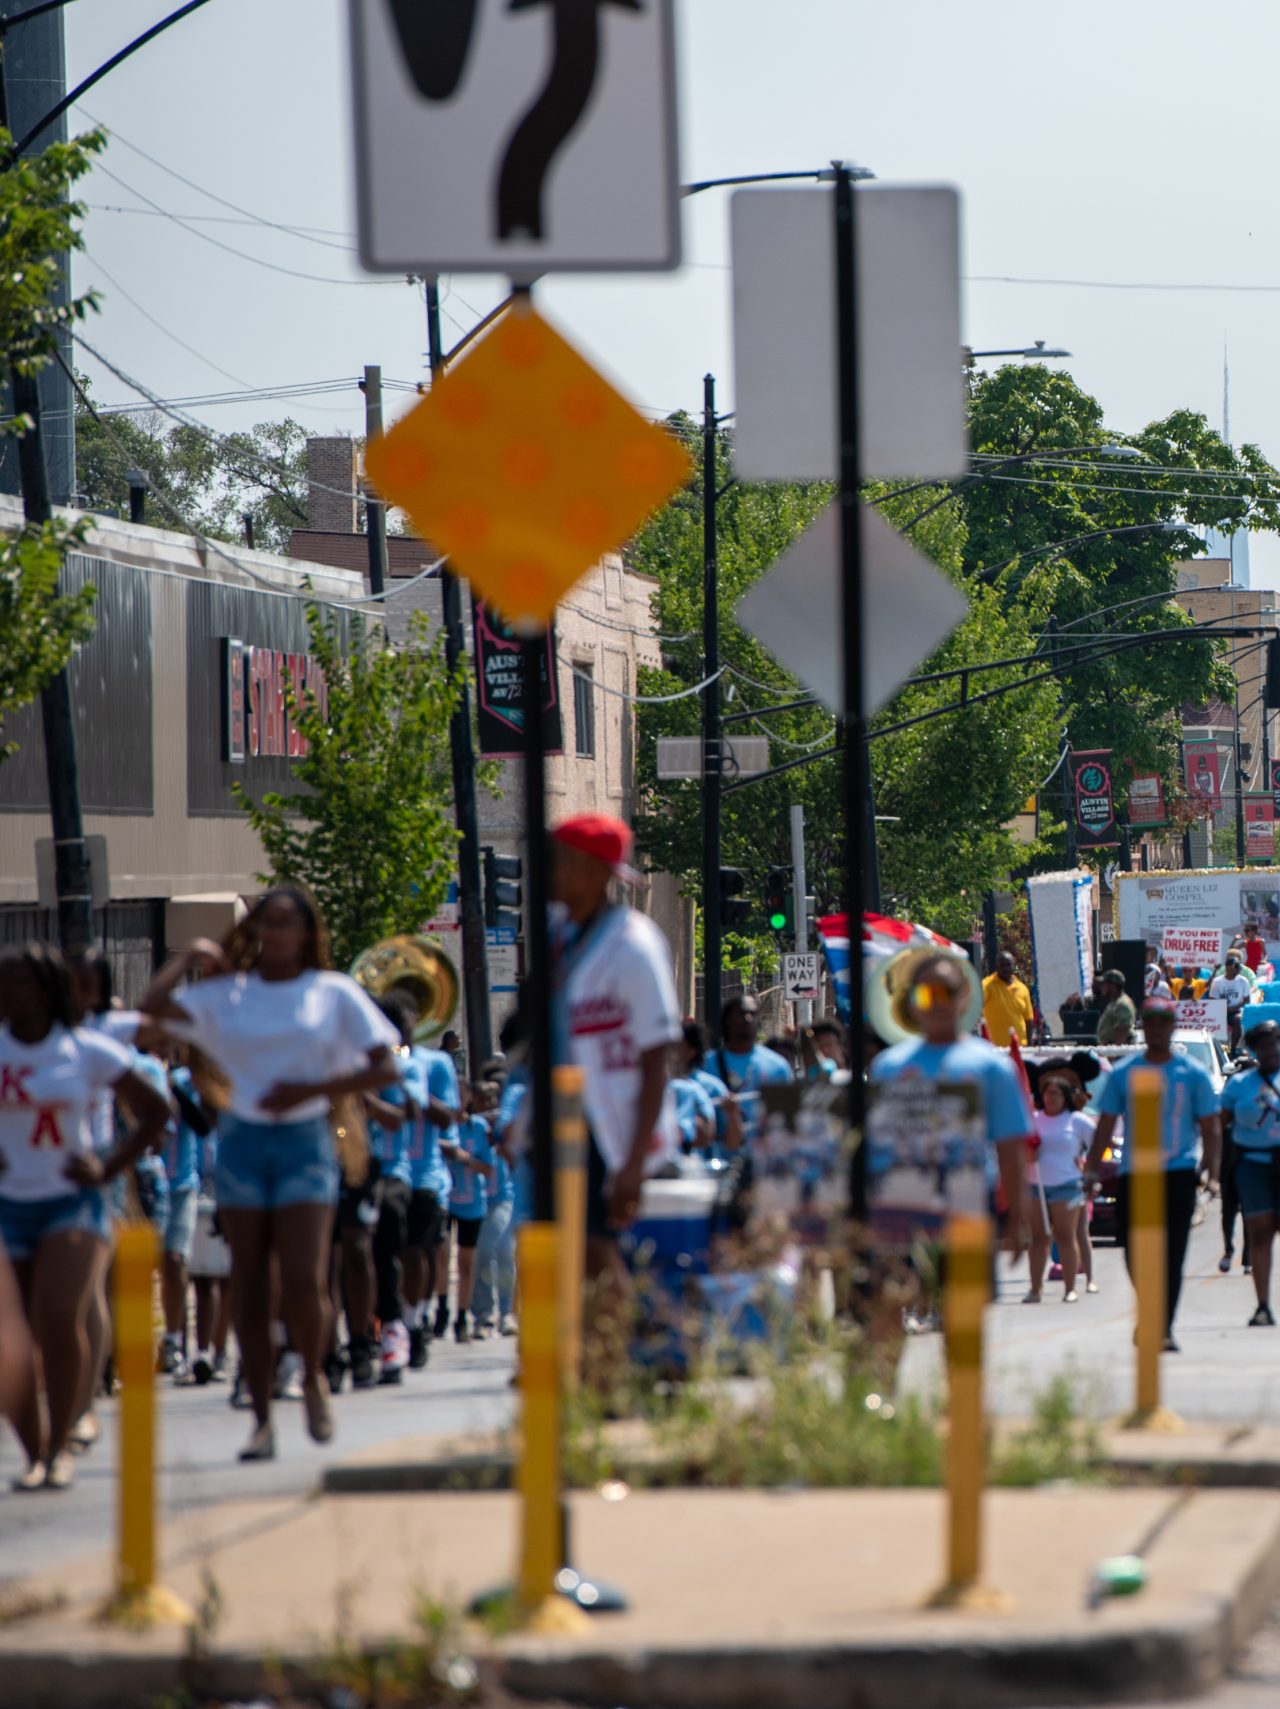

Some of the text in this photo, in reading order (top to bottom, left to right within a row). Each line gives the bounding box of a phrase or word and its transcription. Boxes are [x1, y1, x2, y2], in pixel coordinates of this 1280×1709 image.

[1080, 797, 1109, 808] AUSTIN
[1081, 806, 1110, 814] VILLAGE
[1165, 893, 1204, 902] GOSPEL
[1164, 938, 1220, 952] DRUG FREE
[787, 956, 814, 968] ONE
[787, 969, 815, 980] WAY
[1181, 1008, 1206, 1017] 99
